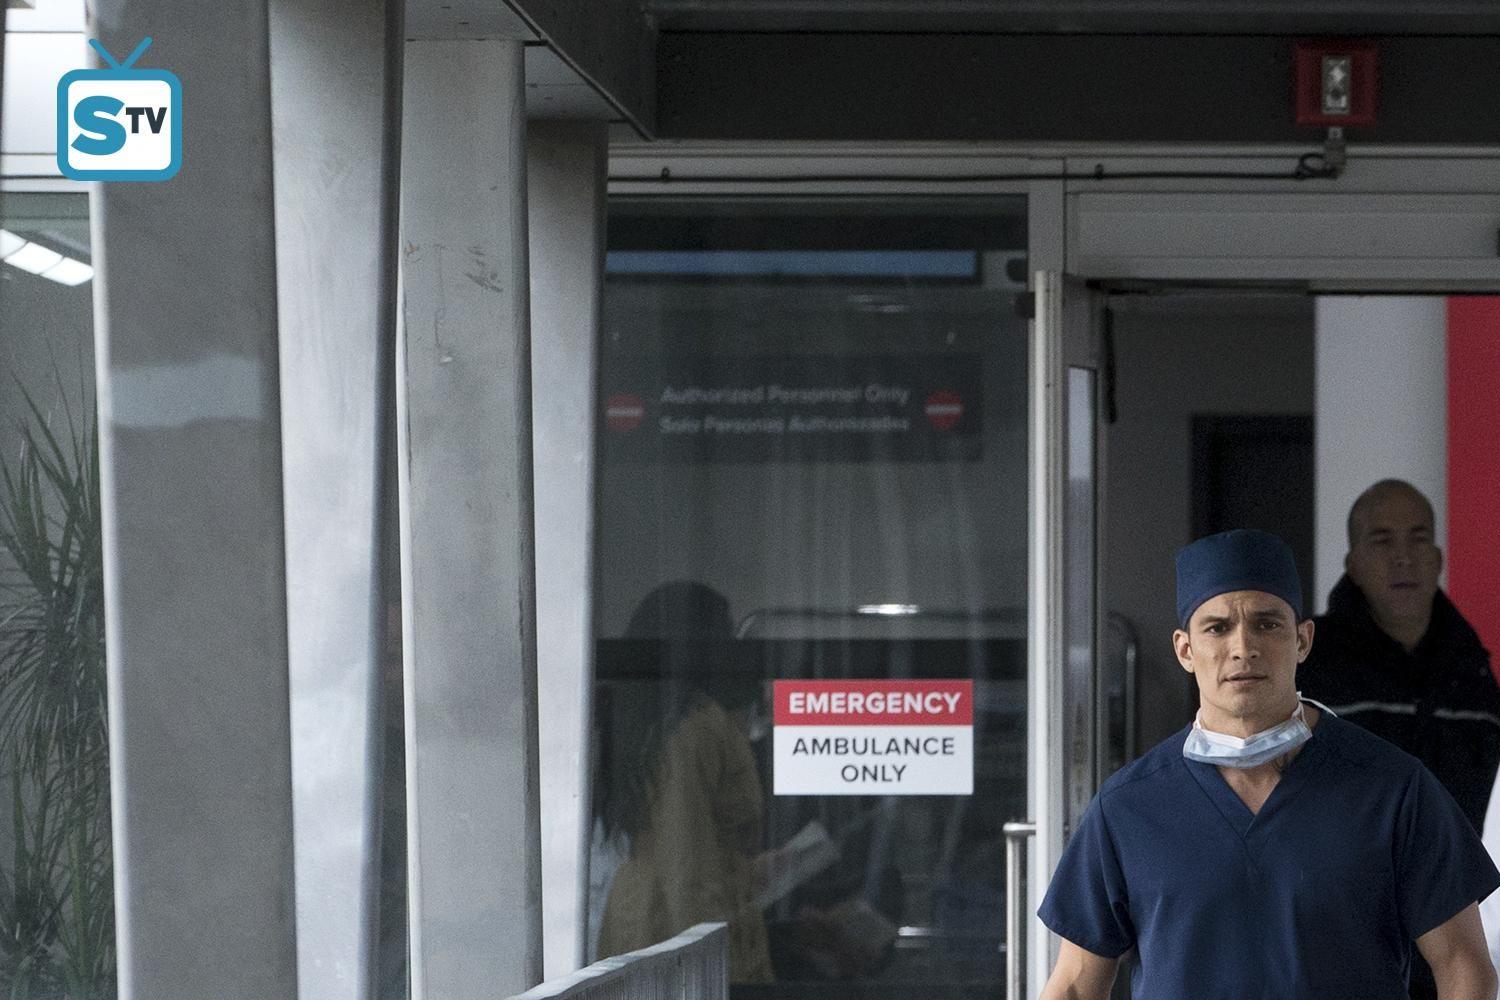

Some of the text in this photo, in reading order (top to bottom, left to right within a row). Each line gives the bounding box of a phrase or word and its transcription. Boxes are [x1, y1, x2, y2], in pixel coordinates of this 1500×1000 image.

[661, 383, 910, 406] Authorized Personnel Only
[789, 692, 961, 714] EMERGENCY
[792, 738, 955, 755] AMBULANCE
[841, 764, 906, 782] ONLY
